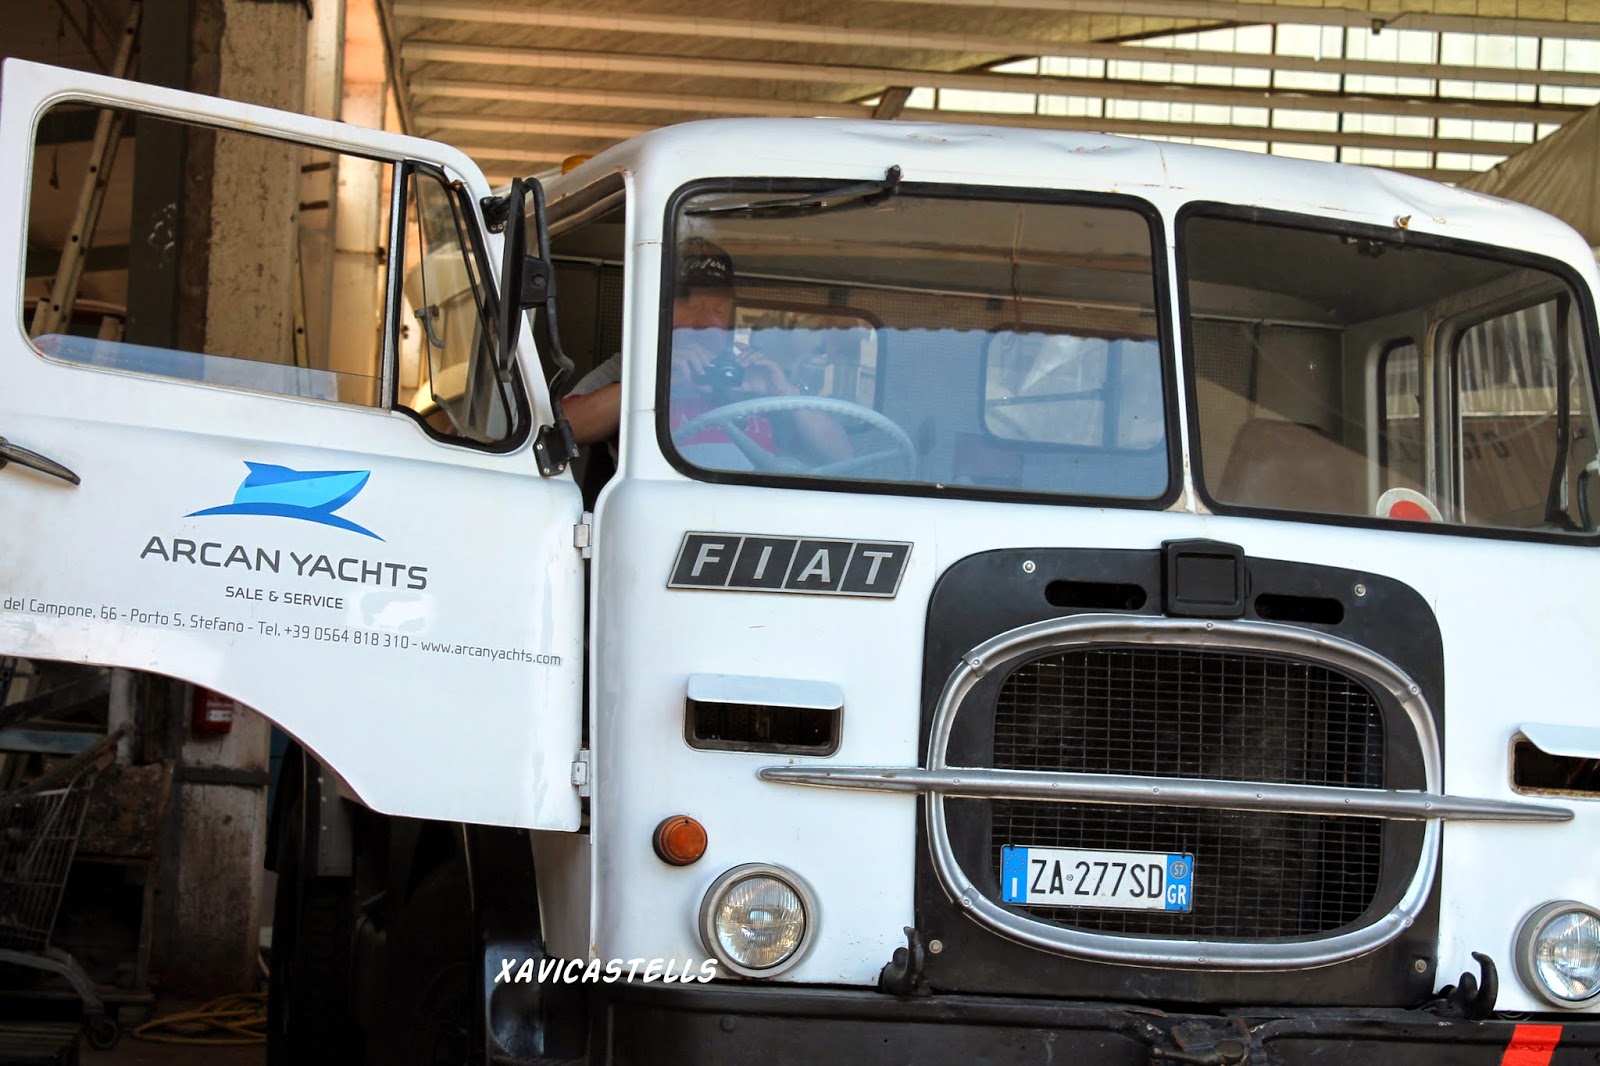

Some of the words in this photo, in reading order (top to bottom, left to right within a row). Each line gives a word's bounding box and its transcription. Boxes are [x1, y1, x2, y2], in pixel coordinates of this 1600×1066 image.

[140, 535, 281, 574] ARCAN
[289, 550, 428, 590] YACHTS
[690, 543, 894, 585] FIAT
[225, 585, 263, 601] SALE
[268, 590, 279, 602] &
[284, 592, 344, 609] SERVICE
[3, 597, 25, 611] del
[100, 605, 118, 621] 66
[130, 608, 169, 626] Porto
[173, 613, 186, 628] S.
[190, 614, 244, 633] Stefano
[257, 620, 281, 637] Tel.
[284, 624, 310, 640] +39
[314, 626, 349, 643] 0564
[353, 630, 379, 646] 818
[383, 633, 409, 650] 310
[421, 641, 562, 666] www.arcanyachts.com
[1167, 884, 1187, 905] GR
